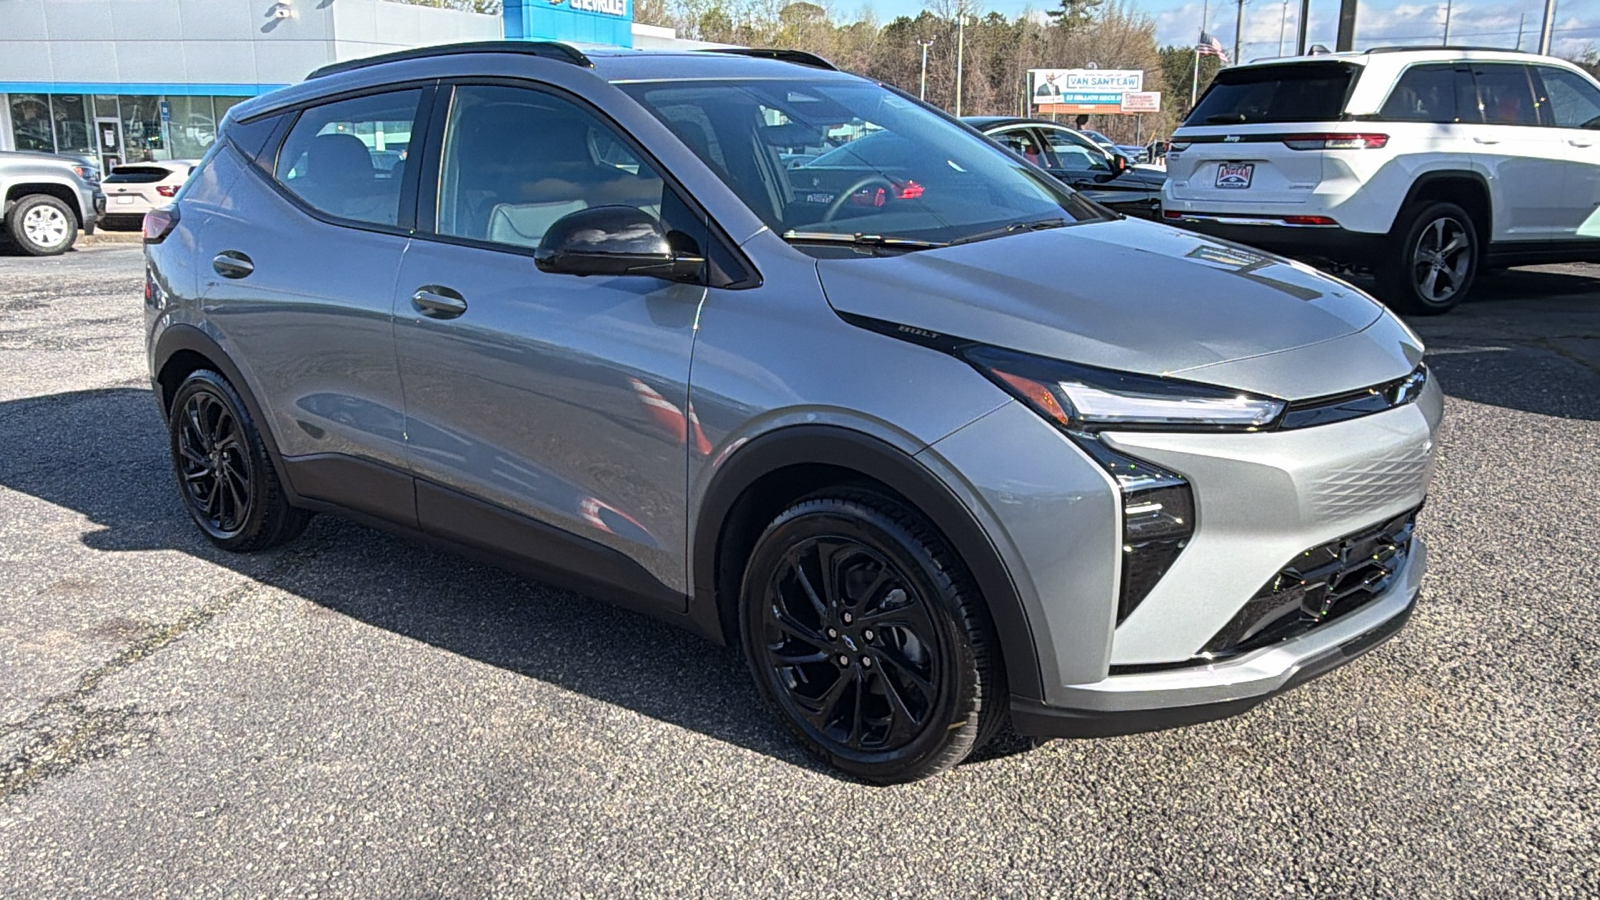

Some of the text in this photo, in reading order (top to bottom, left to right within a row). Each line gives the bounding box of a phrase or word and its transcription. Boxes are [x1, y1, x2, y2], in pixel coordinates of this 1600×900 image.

[1071, 77, 1136, 86] VAN SANT LAW
[1223, 134, 1240, 142] Jeep
[898, 325, 941, 339] BOLT
